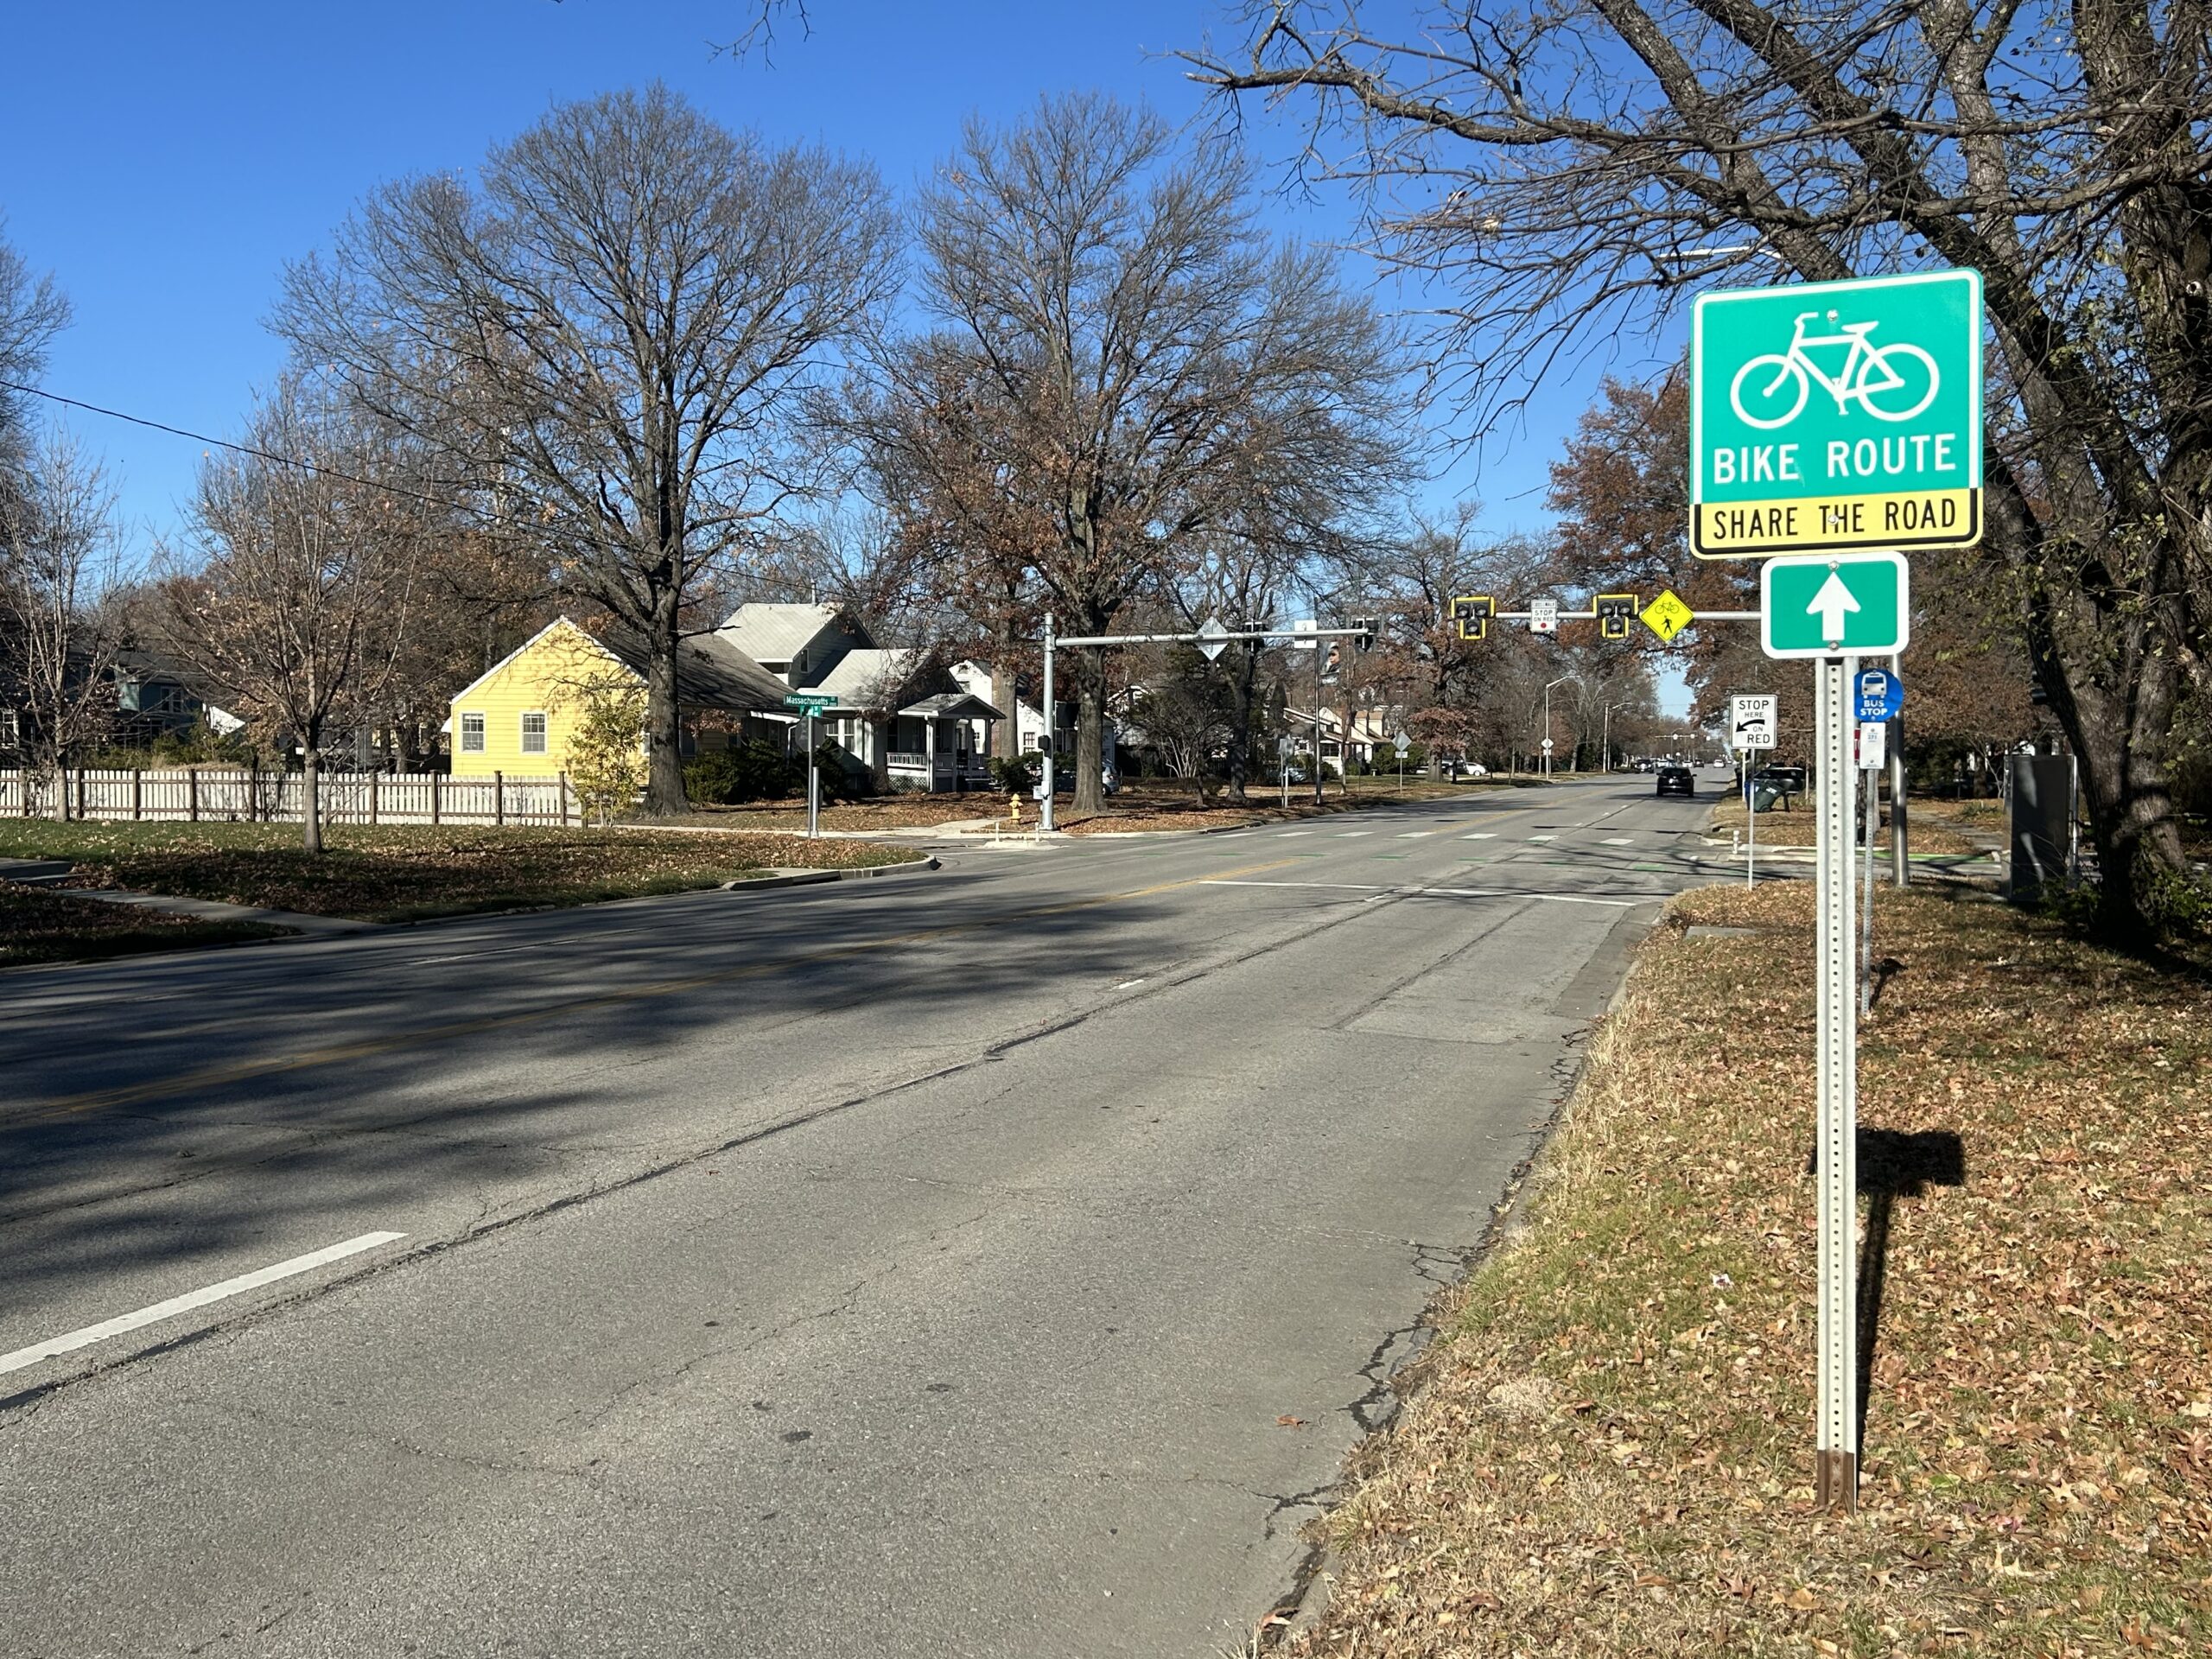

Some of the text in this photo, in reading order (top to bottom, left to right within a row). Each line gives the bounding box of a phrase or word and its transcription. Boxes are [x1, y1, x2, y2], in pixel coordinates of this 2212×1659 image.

[1713, 434, 1956, 485] BIKE ROUTE
[1713, 498, 1955, 540] SHARE THE ROAD
[786, 696, 828, 705] Massachusetts
[1738, 700, 1770, 710] STOP
[1860, 708, 1888, 716] STOP
[1747, 734, 1770, 744] RED
